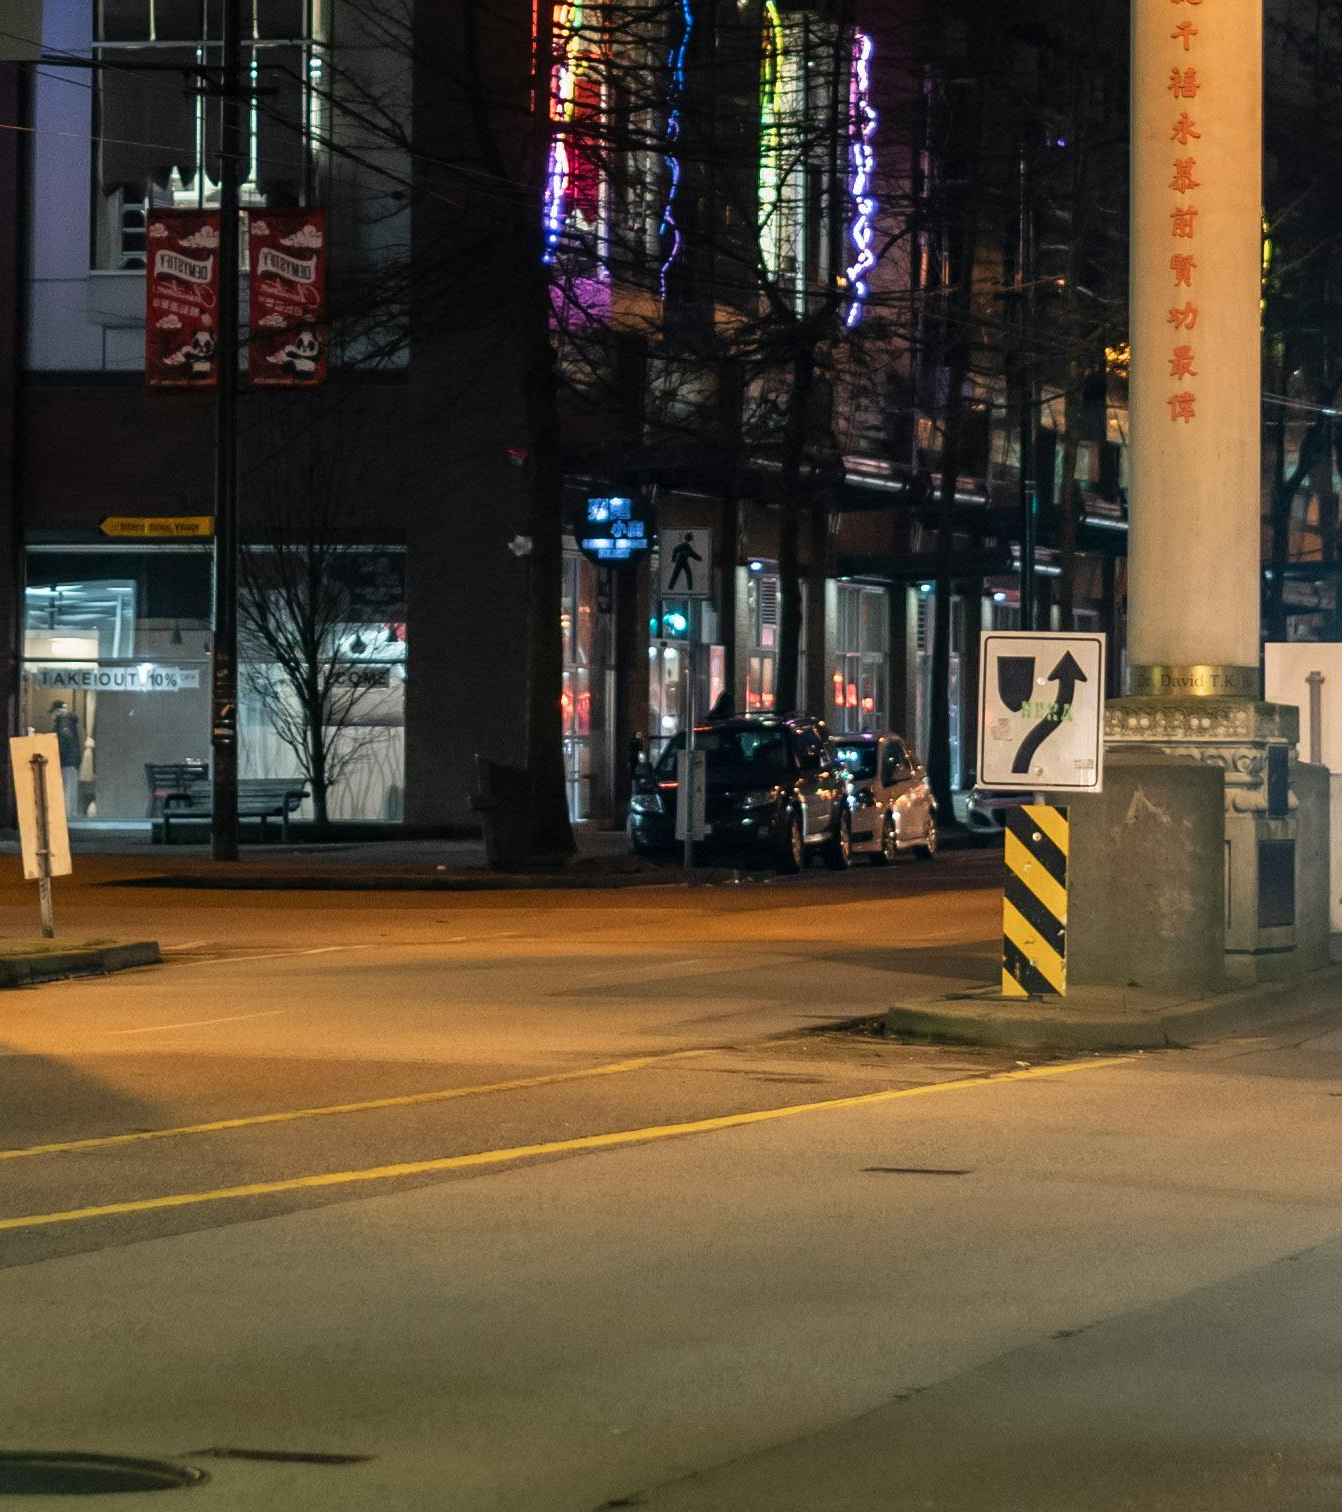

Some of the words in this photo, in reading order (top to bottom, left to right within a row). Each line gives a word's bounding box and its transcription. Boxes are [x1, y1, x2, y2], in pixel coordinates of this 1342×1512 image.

[42, 673, 92, 686] TAKE
[101, 673, 135, 686] OUT
[149, 674, 177, 687] 10%
[1161, 674, 1204, 687] David
